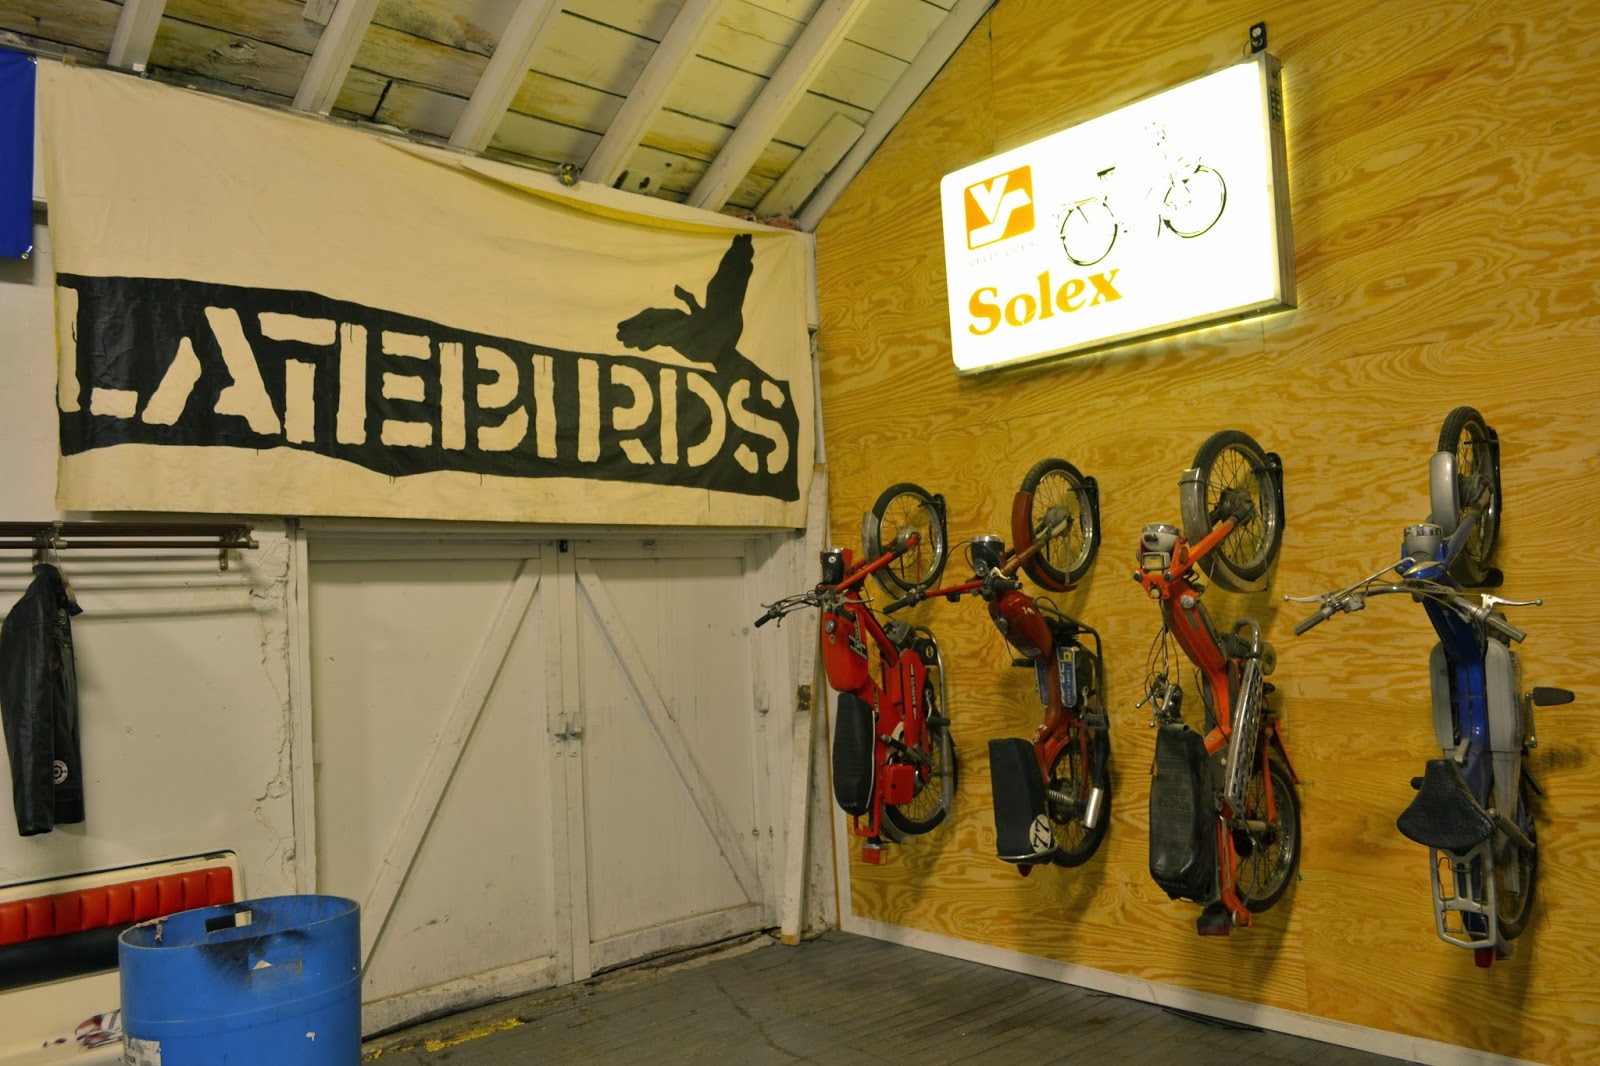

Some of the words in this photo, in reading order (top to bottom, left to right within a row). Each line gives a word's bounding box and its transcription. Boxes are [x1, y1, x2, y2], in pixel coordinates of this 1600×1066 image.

[968, 268, 1123, 336] Solex
[58, 286, 790, 474] LATEBIRDS
[1033, 818, 1050, 848] 77
